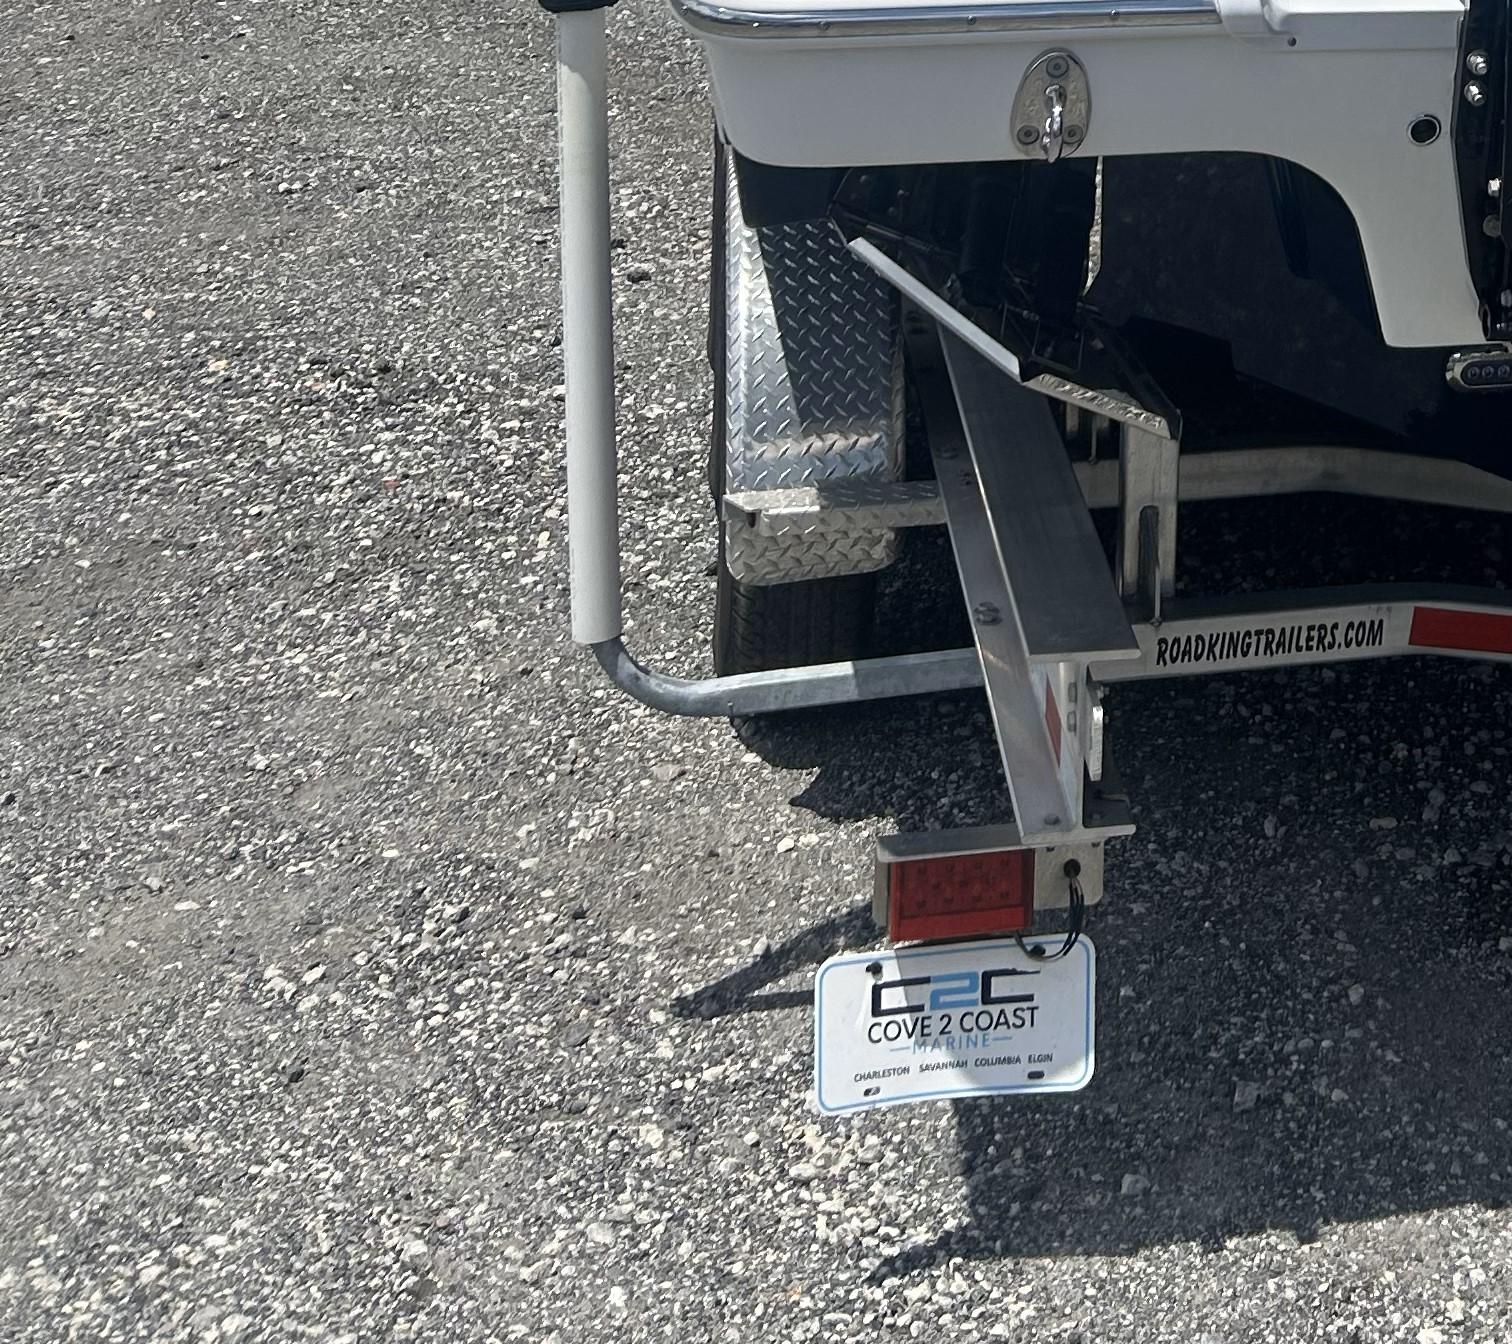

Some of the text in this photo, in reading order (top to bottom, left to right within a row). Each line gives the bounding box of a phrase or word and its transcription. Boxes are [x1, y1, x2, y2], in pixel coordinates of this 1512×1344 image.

[1156, 618, 1384, 667] ROADKINGTRAILERS.COM
[871, 968, 1041, 1018] C2C
[868, 1006, 1039, 1044] COVE 2 COAST
[912, 1034, 991, 1055] MARINE
[854, 1053, 1053, 1083] CHARLESTON SAVANNAH COLUMBIA ELGIN
